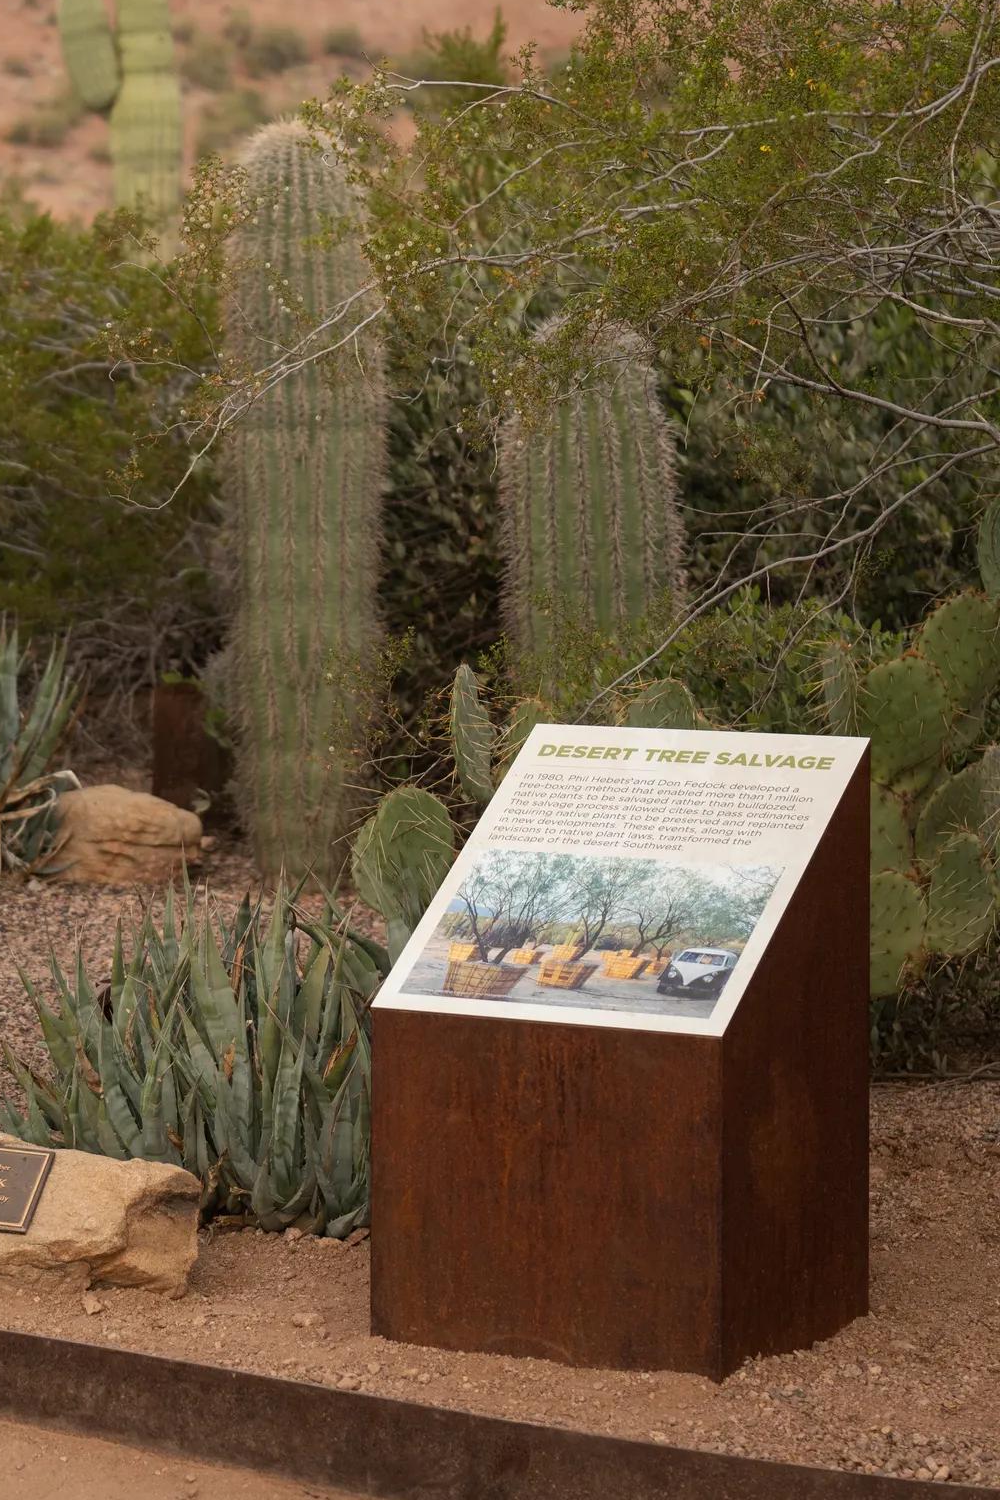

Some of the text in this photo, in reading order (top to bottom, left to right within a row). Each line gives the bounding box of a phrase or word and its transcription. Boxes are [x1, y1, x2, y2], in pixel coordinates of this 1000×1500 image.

[537, 744, 835, 770] DESERT TREE SALVAGE
[519, 782, 582, 791] tree-boxing
[585, 785, 629, 793] method
[657, 789, 703, 797] enabled
[775, 794, 814, 803] million
[684, 781, 725, 789] Fedock
[729, 783, 791, 793] developed
[510, 798, 529, 806] The
[532, 800, 573, 809] salvage
[622, 805, 667, 813] allowed
[669, 807, 699, 815] cities
[717, 810, 743, 818] pass
[746, 812, 810, 821] ordinances
[549, 792, 583, 800] plants
[619, 795, 669, 804] salvaged
[709, 800, 734, 808] than
[504, 808, 553, 817] requiring
[556, 810, 589, 818] native
[592, 812, 626, 820] plants
[662, 816, 720, 825] preserved
[747, 821, 804, 830] replanted
[493, 825, 541, 833] revisions
[659, 834, 730, 844] transformed
[623, 822, 655, 830] These
[701, 827, 733, 836] along
[488, 833, 544, 843] landscape
[562, 837, 580, 845] the
[583, 838, 620, 847] desert
